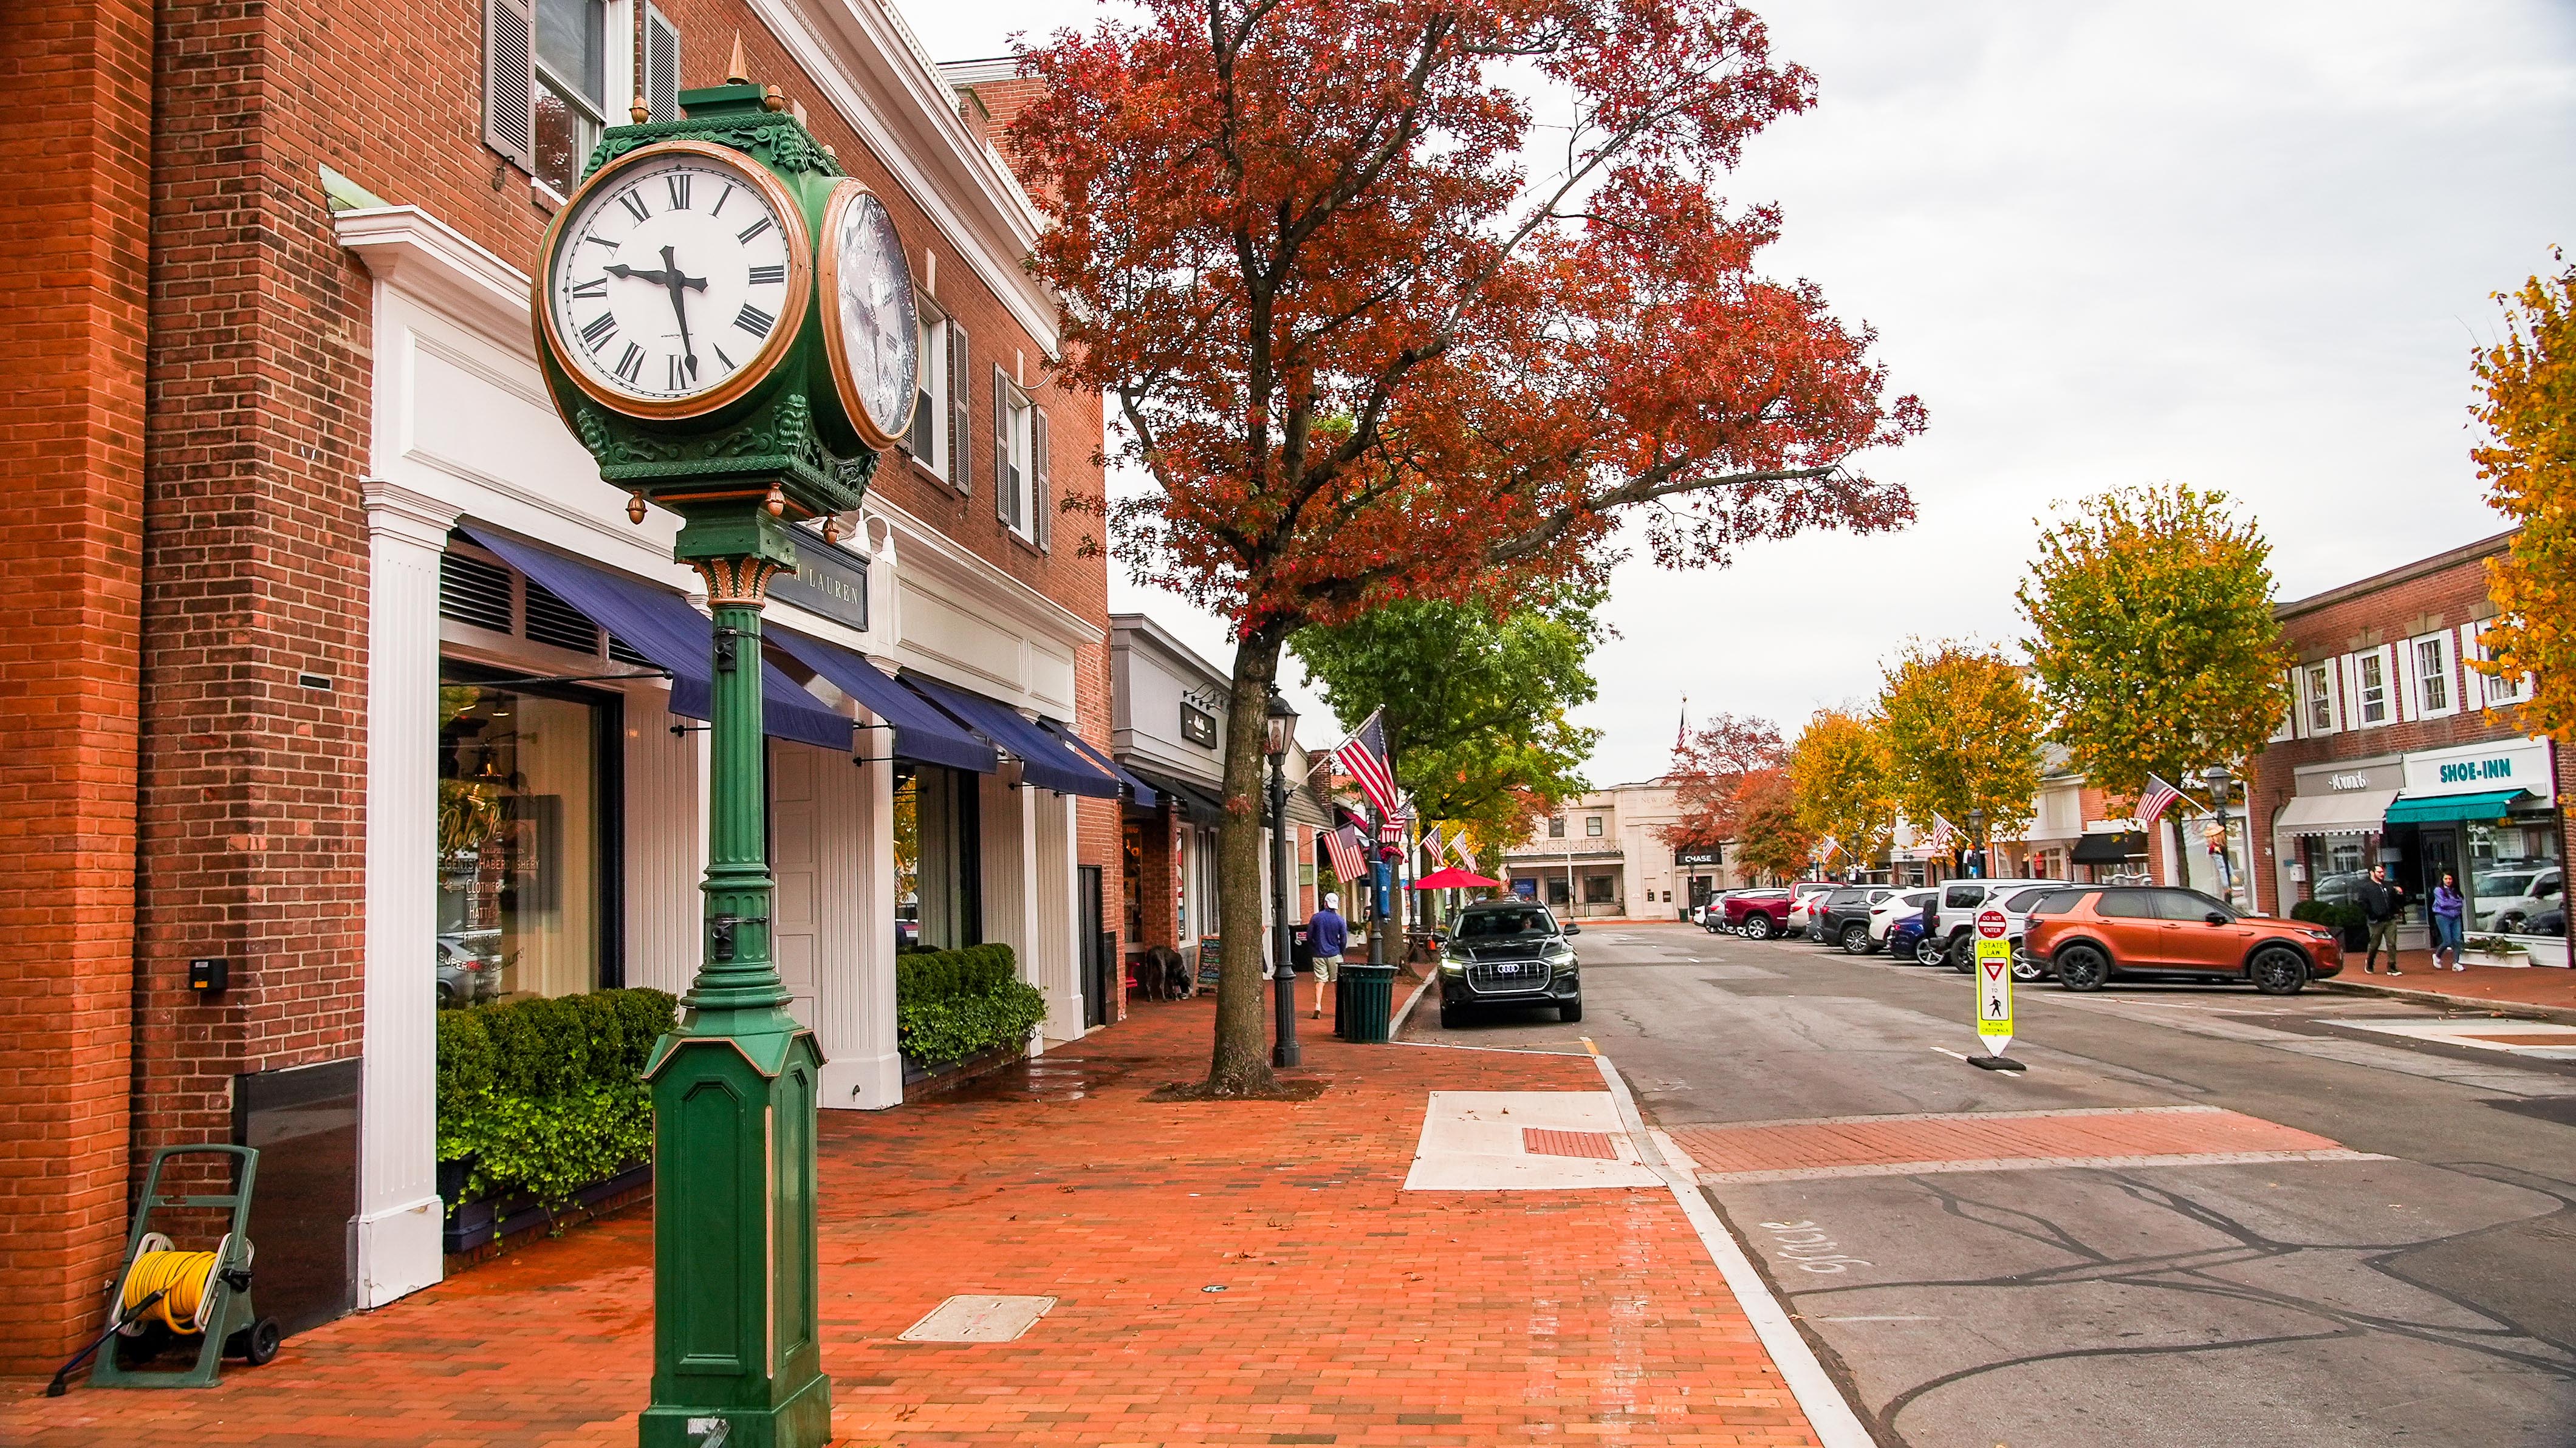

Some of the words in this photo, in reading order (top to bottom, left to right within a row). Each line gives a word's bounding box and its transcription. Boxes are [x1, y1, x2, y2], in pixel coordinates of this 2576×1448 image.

[809, 569, 858, 605] LAUREN
[2440, 758, 2511, 783] SHOE-INN
[479, 856, 540, 870] HABERDSHERY
